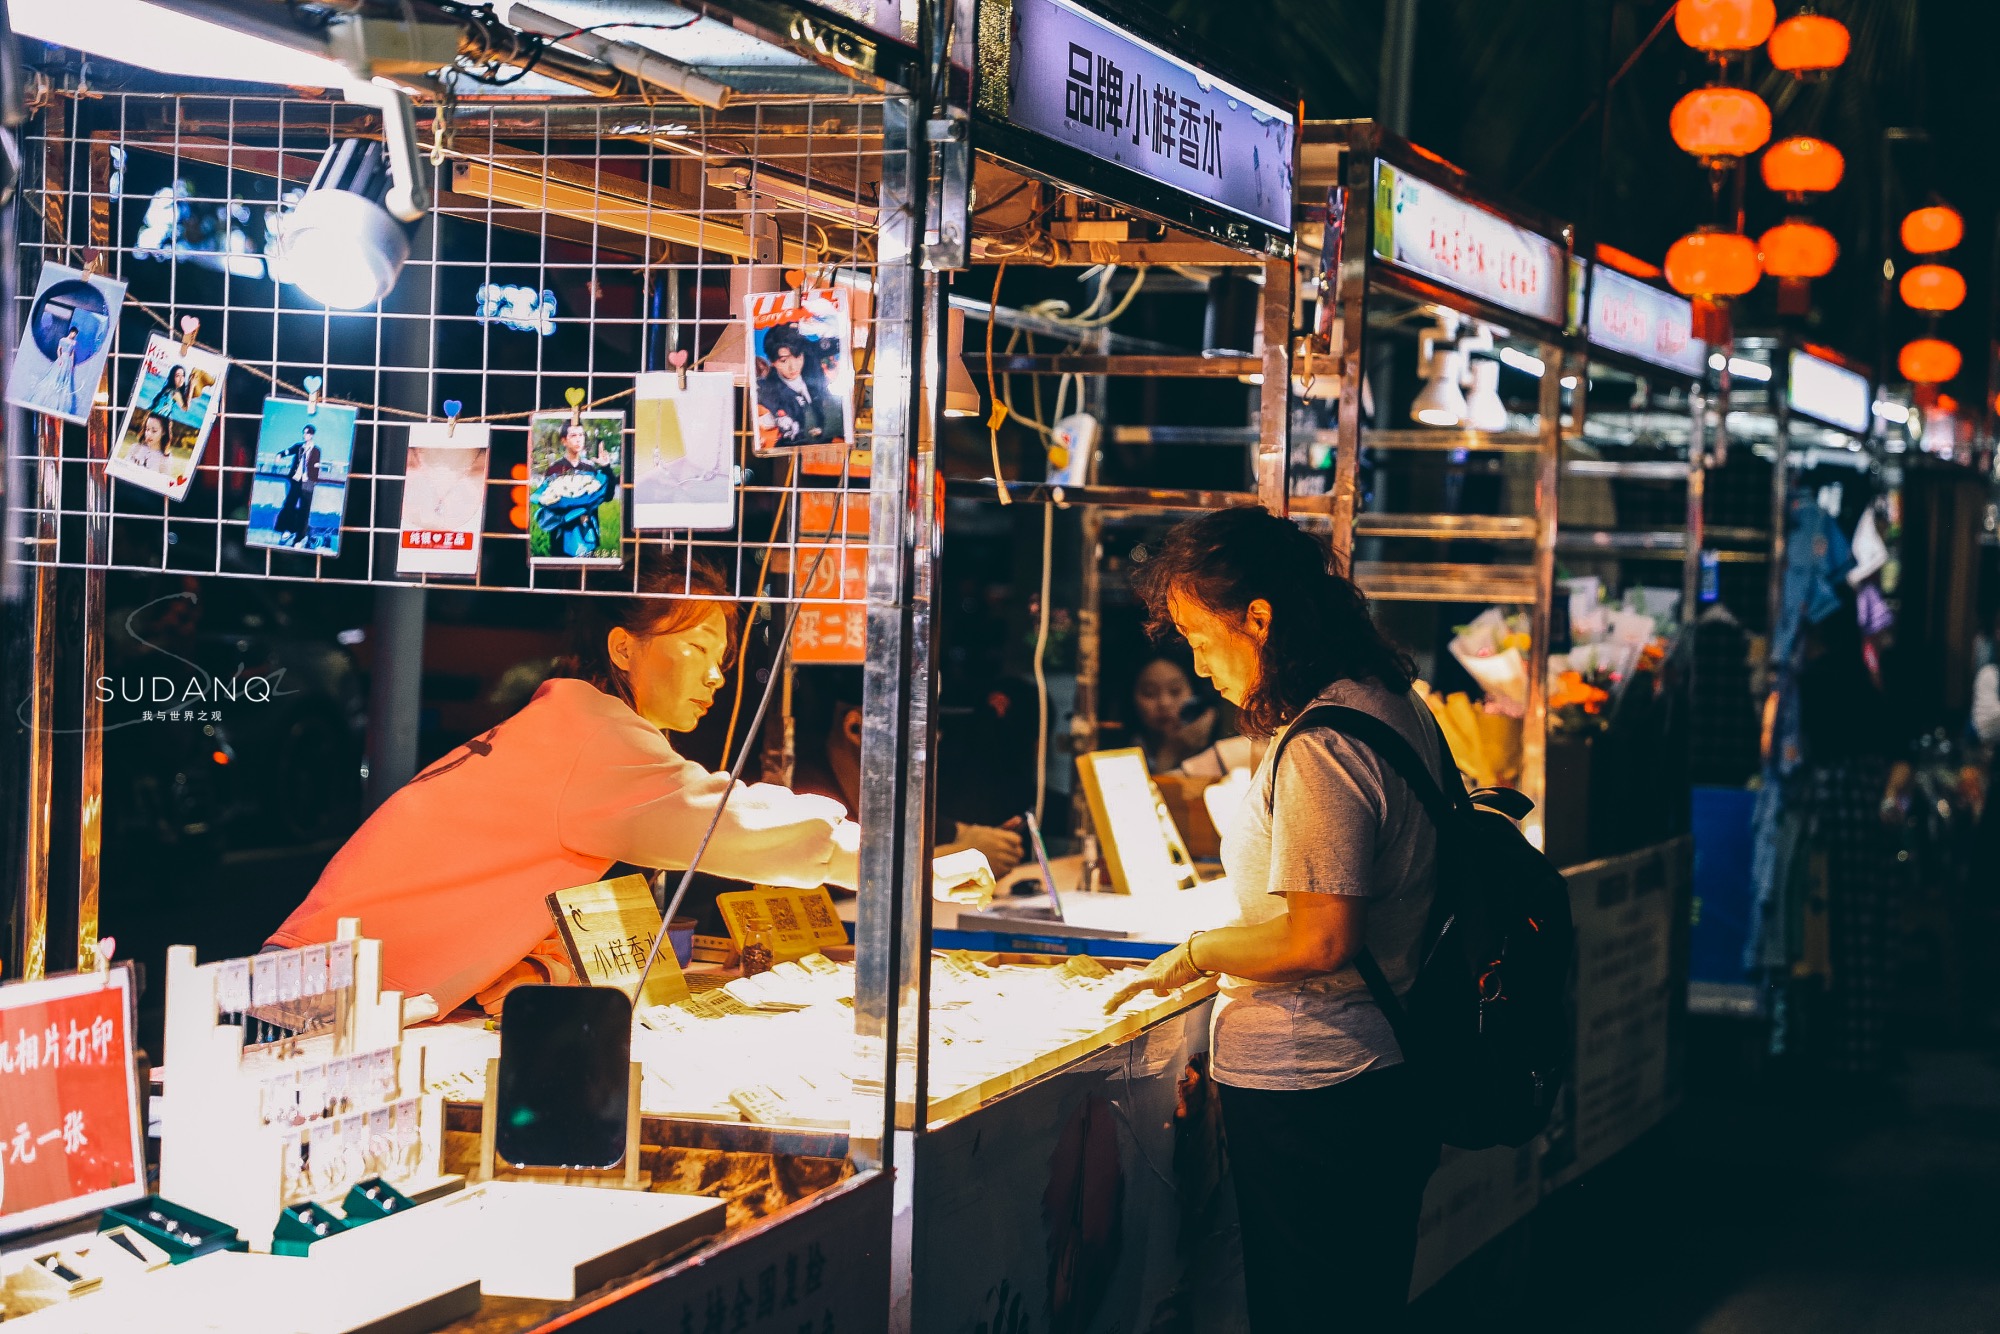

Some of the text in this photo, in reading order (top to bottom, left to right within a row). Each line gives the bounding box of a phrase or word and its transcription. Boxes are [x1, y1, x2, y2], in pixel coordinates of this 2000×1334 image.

[1066, 41, 1222, 179] 品牌小样香水
[594, 931, 666, 978] 小样香水
[0, 1110, 87, 1164] 元一张
